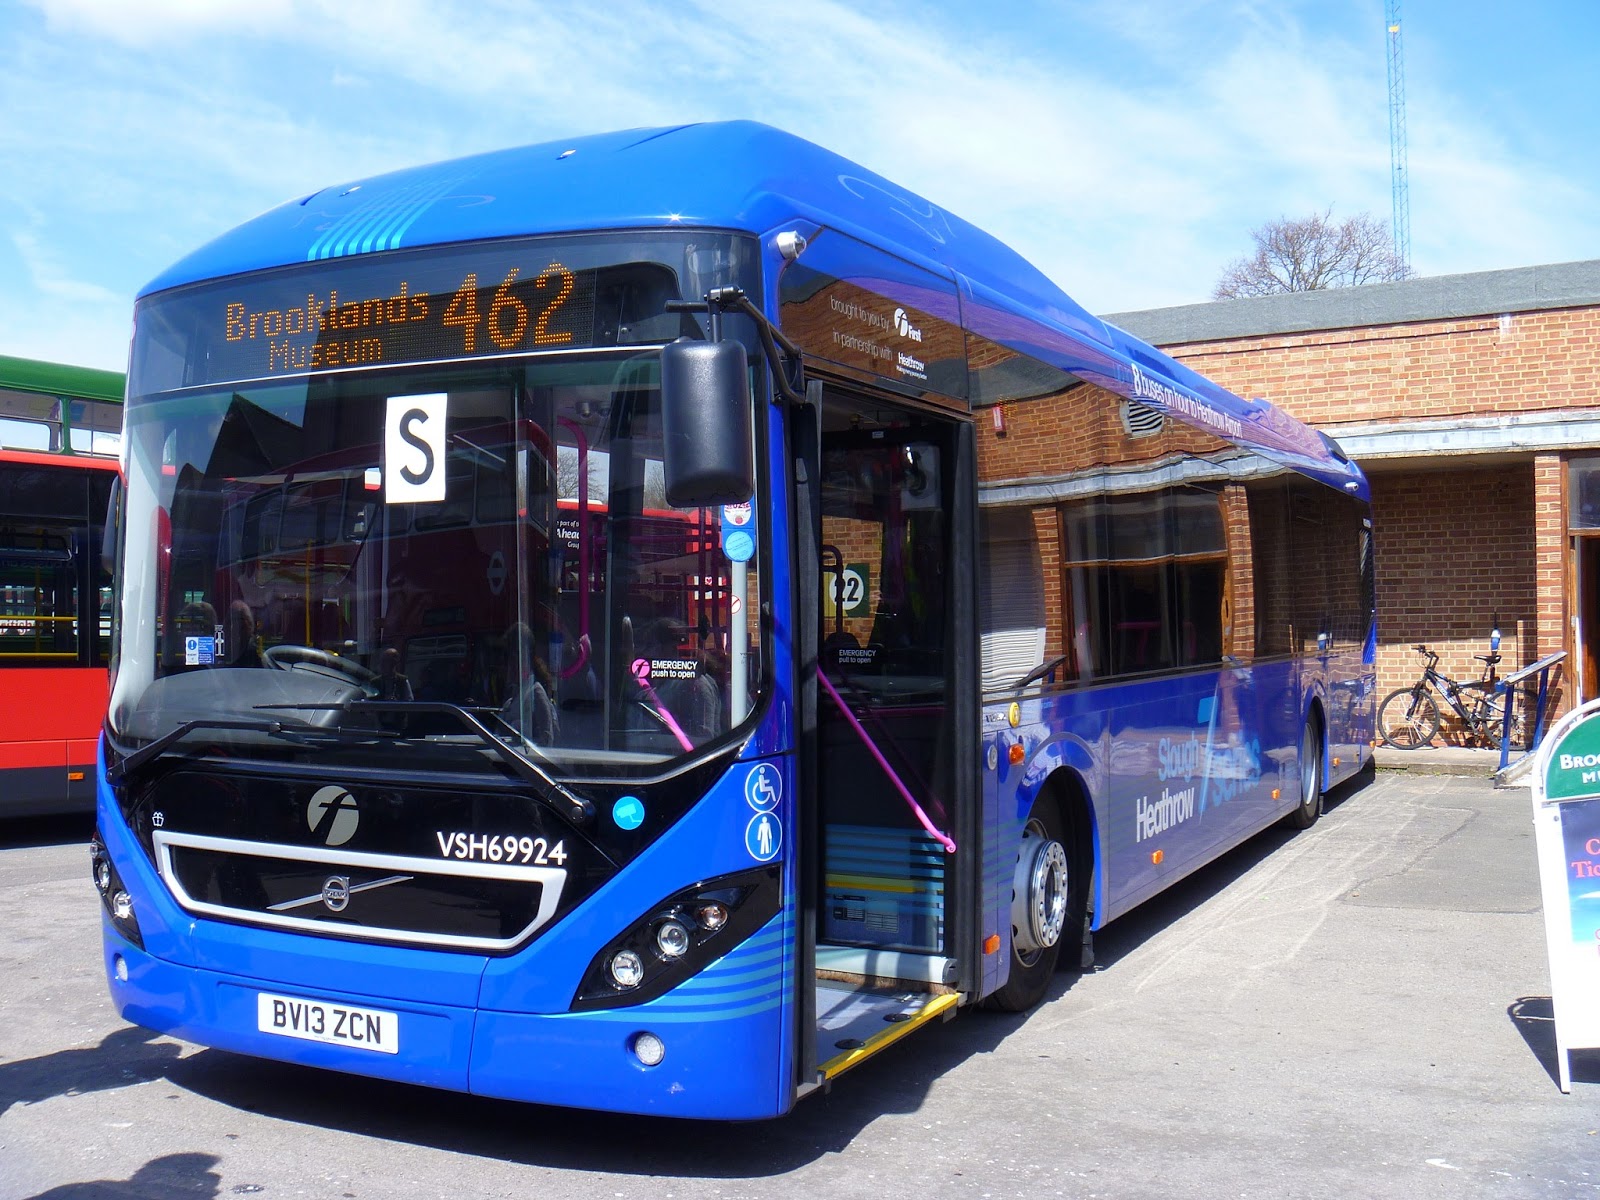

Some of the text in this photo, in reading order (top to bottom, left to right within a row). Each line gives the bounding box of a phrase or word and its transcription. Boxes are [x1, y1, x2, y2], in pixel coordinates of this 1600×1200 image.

[226, 281, 429, 341] Brooklands
[443, 262, 574, 351] 462
[830, 295, 890, 332] brought to you by
[833, 328, 893, 361] in partnership with
[908, 325, 922, 342] First
[269, 338, 382, 370] Museum
[898, 351, 925, 371] Heathrow
[1131, 363, 1142, 396] 8
[1139, 370, 1165, 403] buses
[1172, 386, 1190, 415] hour
[1195, 398, 1225, 430] Heathrow
[1223, 412, 1243, 438] Airport
[399, 408, 435, 486] S
[651, 660, 698, 669] EMERGENCY
[651, 669, 696, 679] push to open
[1158, 731, 1199, 782] Slough
[1136, 787, 1195, 843] Heathrow
[436, 831, 567, 866] VSH69924
[273, 999, 381, 1044] BV13 ZCN
